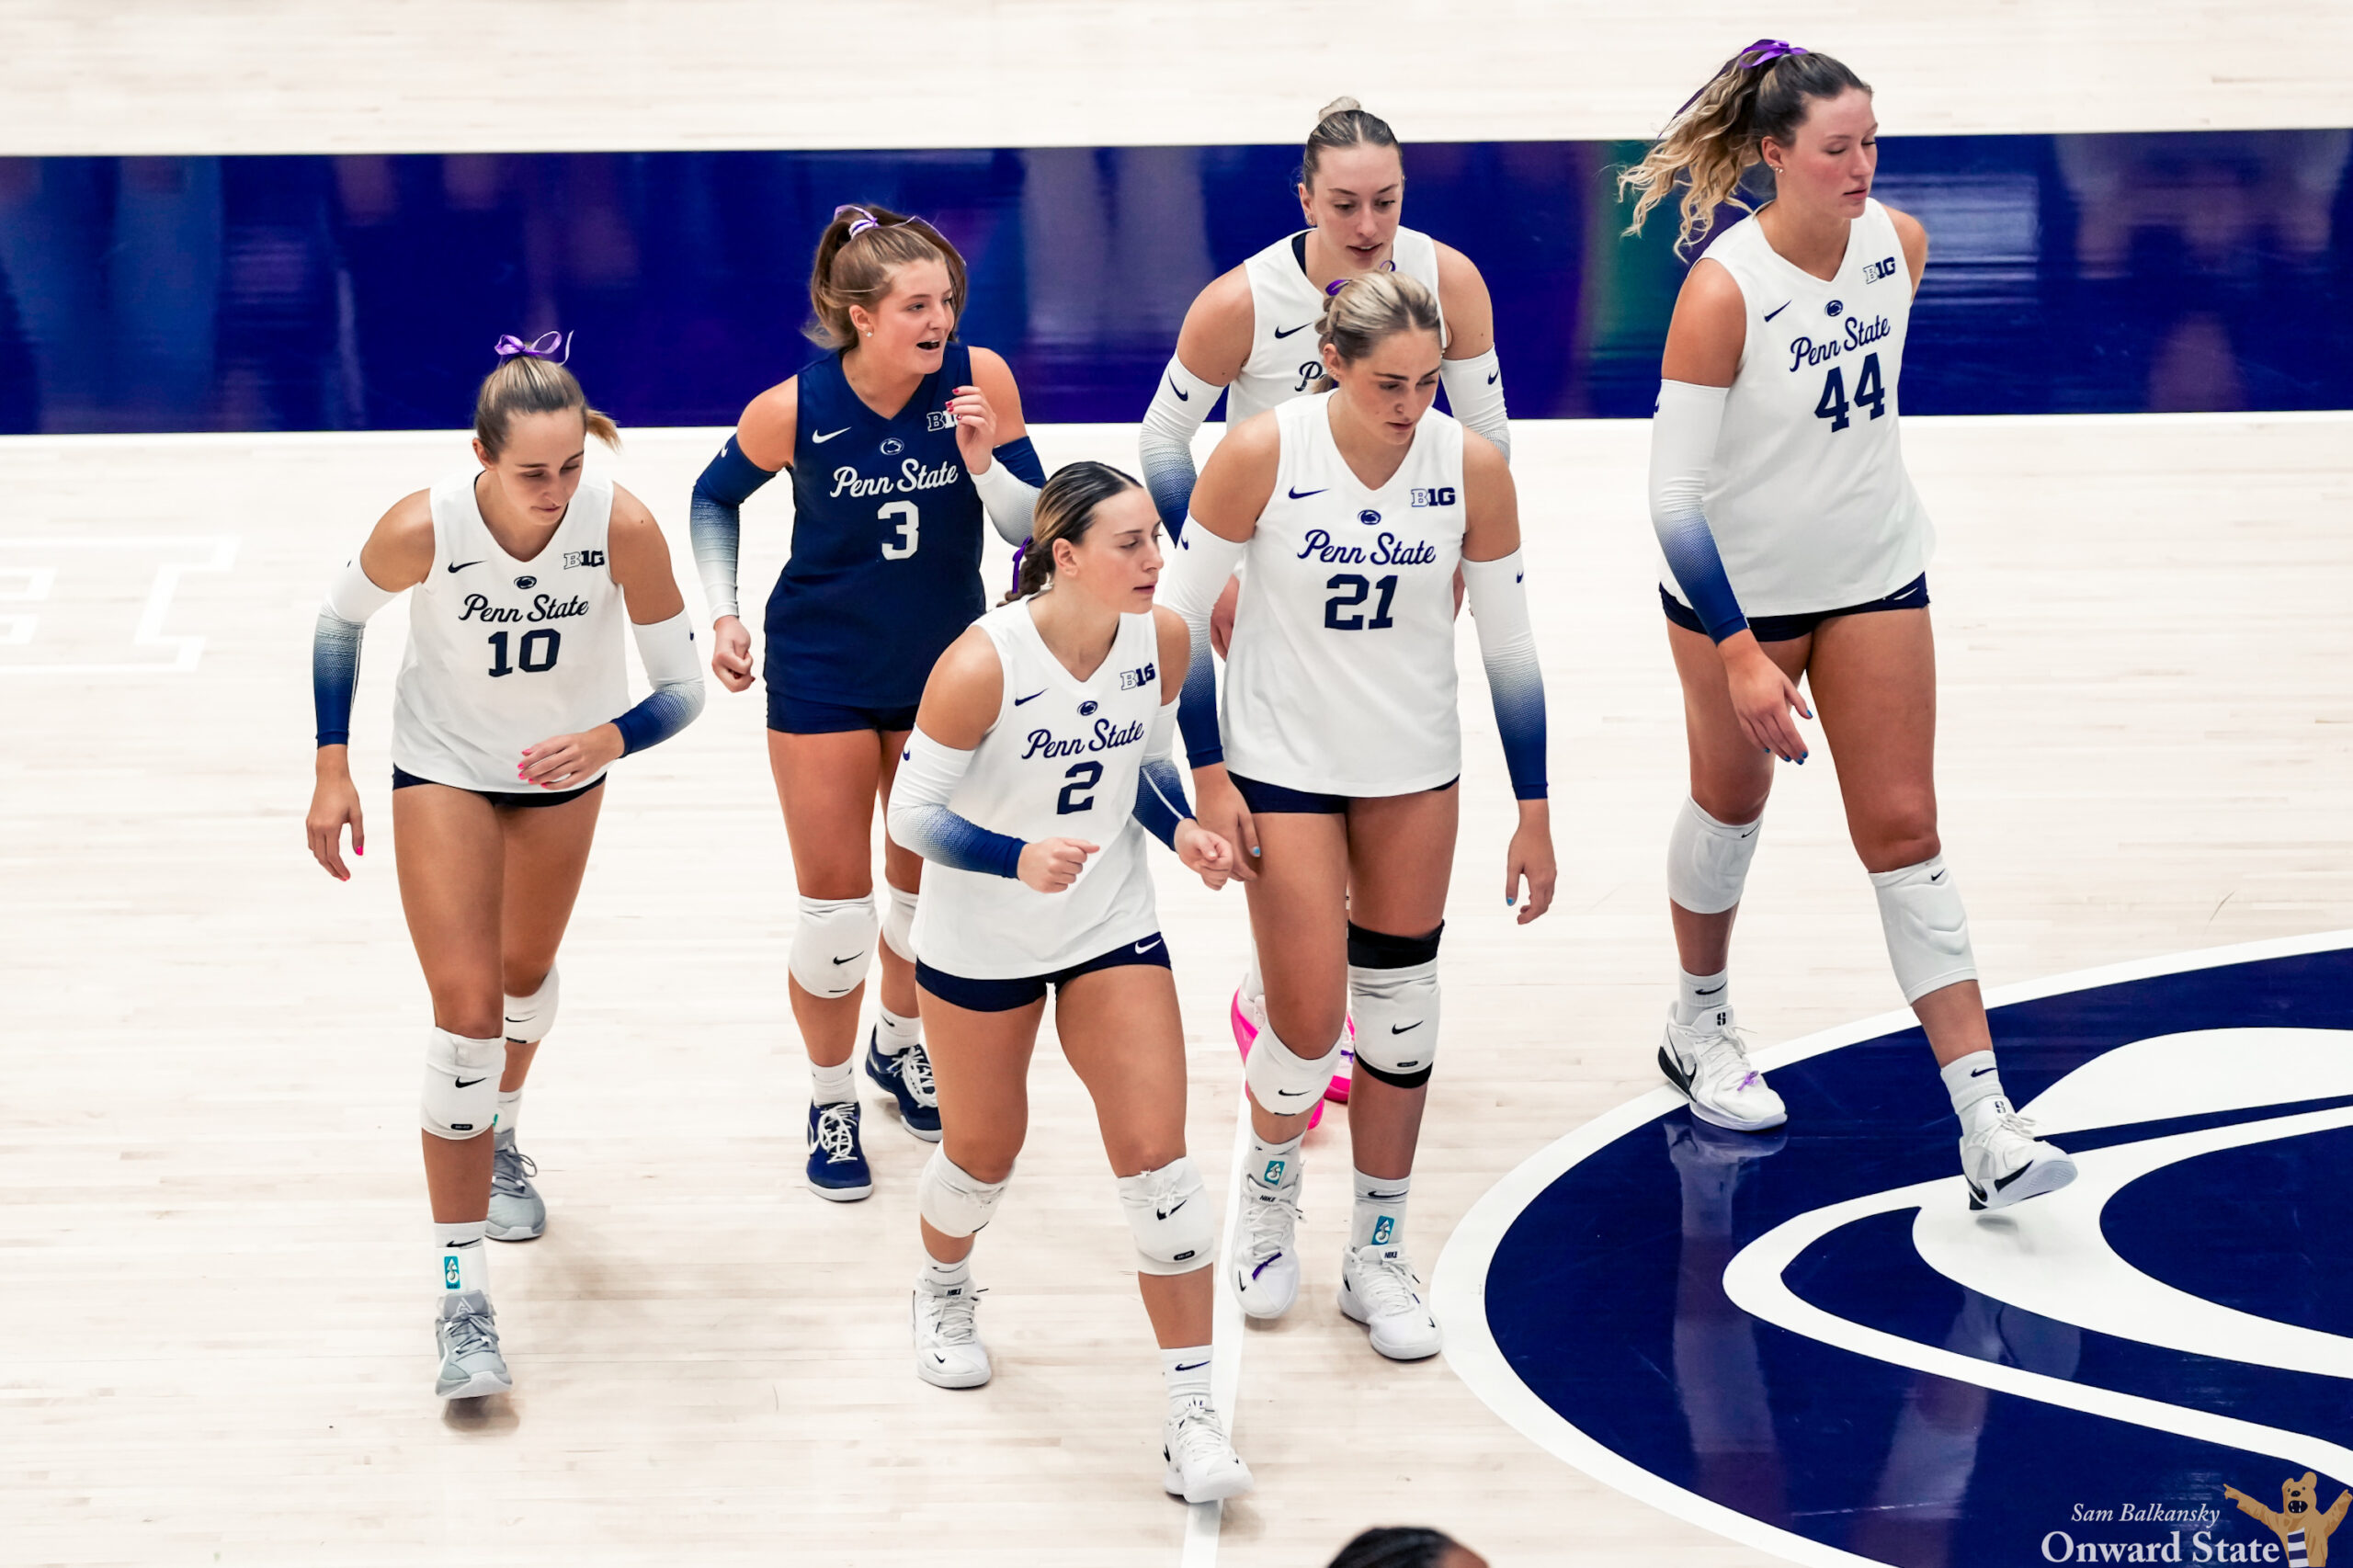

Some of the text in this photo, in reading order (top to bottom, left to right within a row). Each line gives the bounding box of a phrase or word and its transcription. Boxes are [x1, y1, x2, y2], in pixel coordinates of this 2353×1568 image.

[1790, 314, 1891, 372] Penn State
[1814, 352, 1885, 433] 44
[830, 458, 959, 498] Penn State
[877, 500, 919, 561] 3
[1297, 529, 1436, 565] Penn State
[459, 594, 589, 622] Penn State
[1324, 574, 1398, 631] 21
[488, 628, 561, 677] 10
[1021, 718, 1144, 759] Penn State
[1056, 760, 1104, 814] 2
[1259, 1195, 1277, 1203] NIKE
[1384, 1251, 1398, 1259] NIKE
